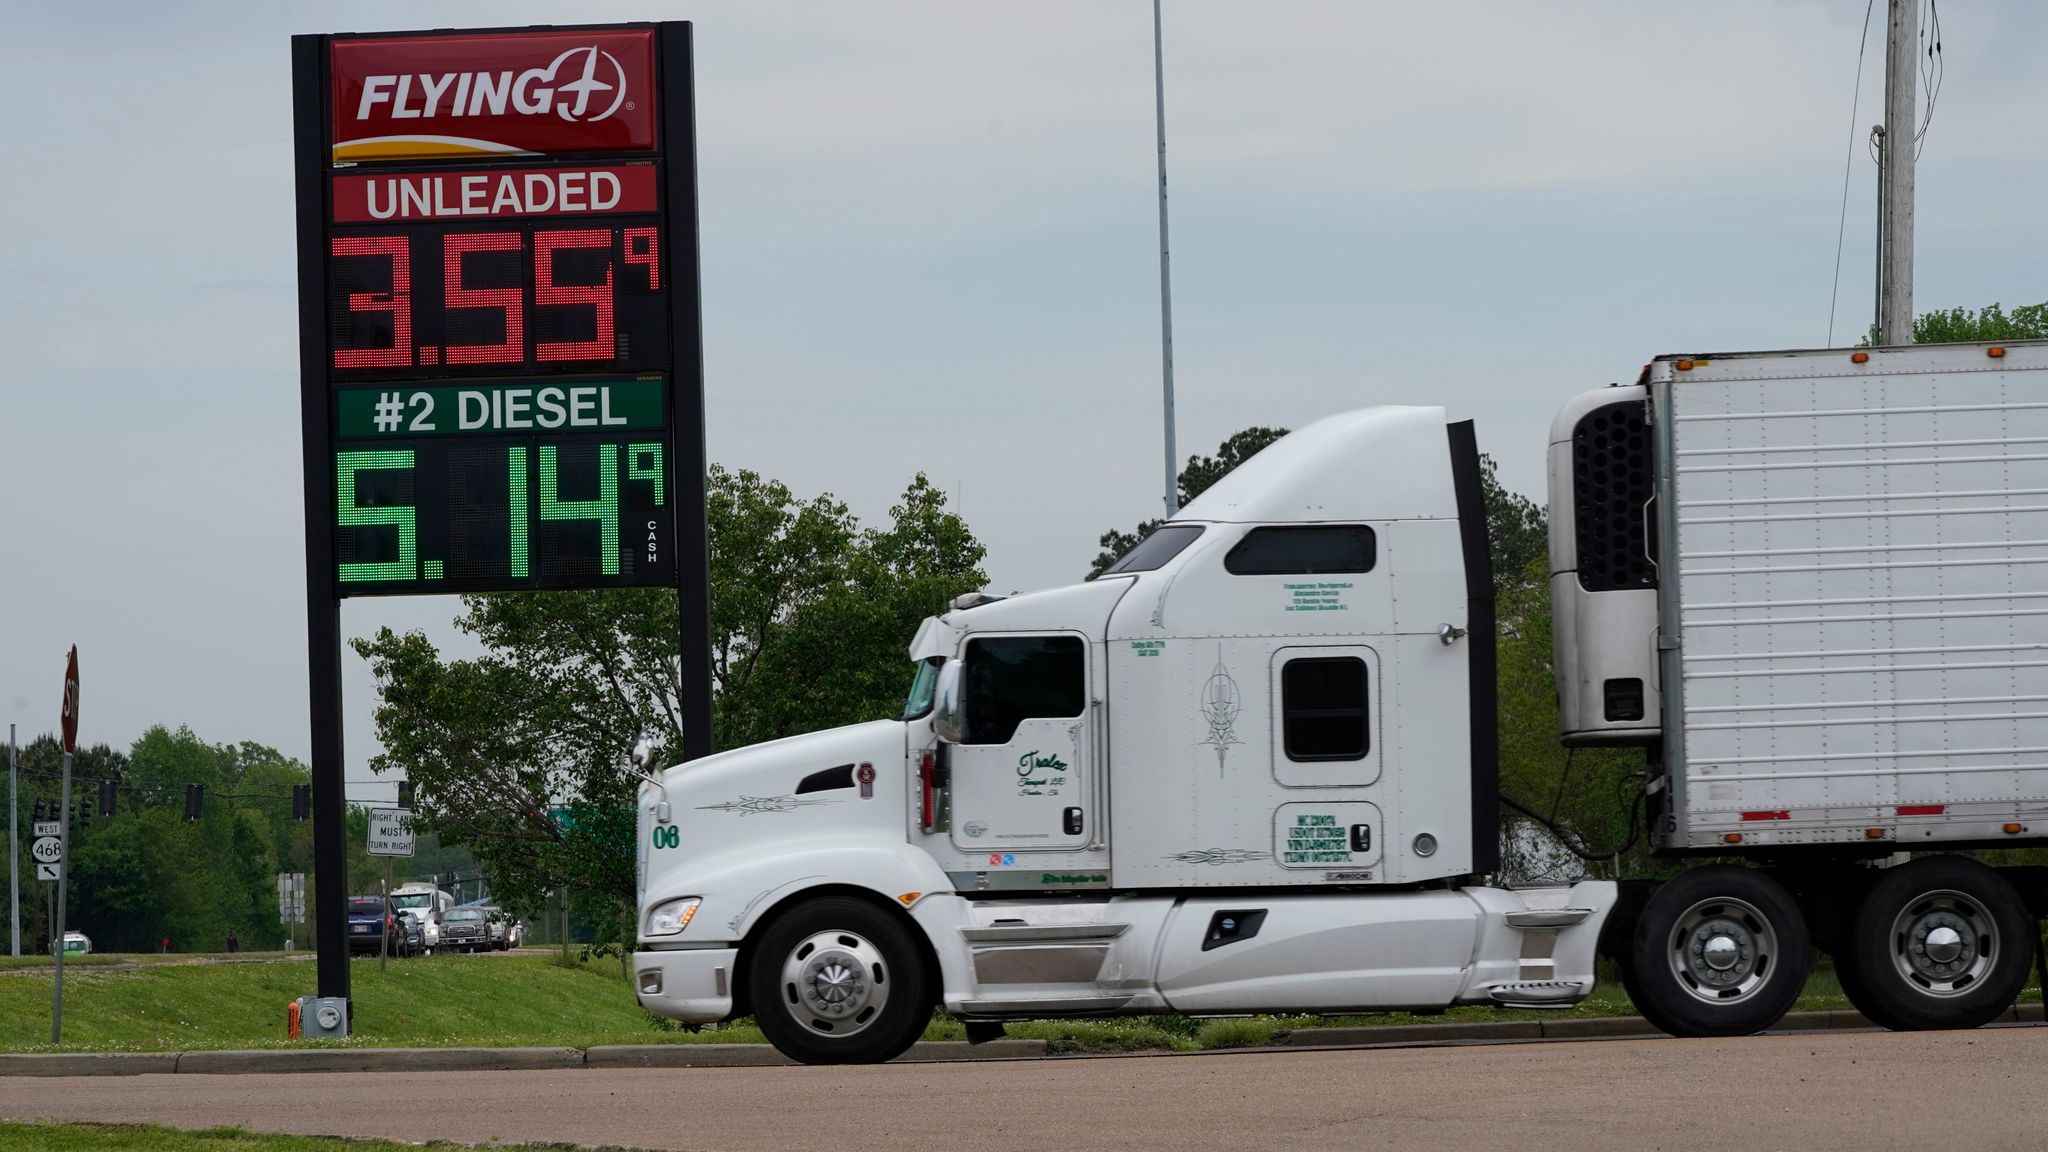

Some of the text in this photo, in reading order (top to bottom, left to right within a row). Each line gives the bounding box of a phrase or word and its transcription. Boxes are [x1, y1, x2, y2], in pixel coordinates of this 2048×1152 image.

[356, 66, 556, 121] FLYING
[366, 171, 622, 219] UNLEADED
[373, 386, 627, 432] #2 DIESEL
[647, 520, 657, 562] CASH
[372, 813, 392, 822] RIGHT
[37, 824, 58, 834] WEST
[380, 827, 402, 837] MUST
[653, 825, 680, 850] 06
[36, 842, 61, 857] 468
[370, 841, 411, 850] TURN RIGHT
